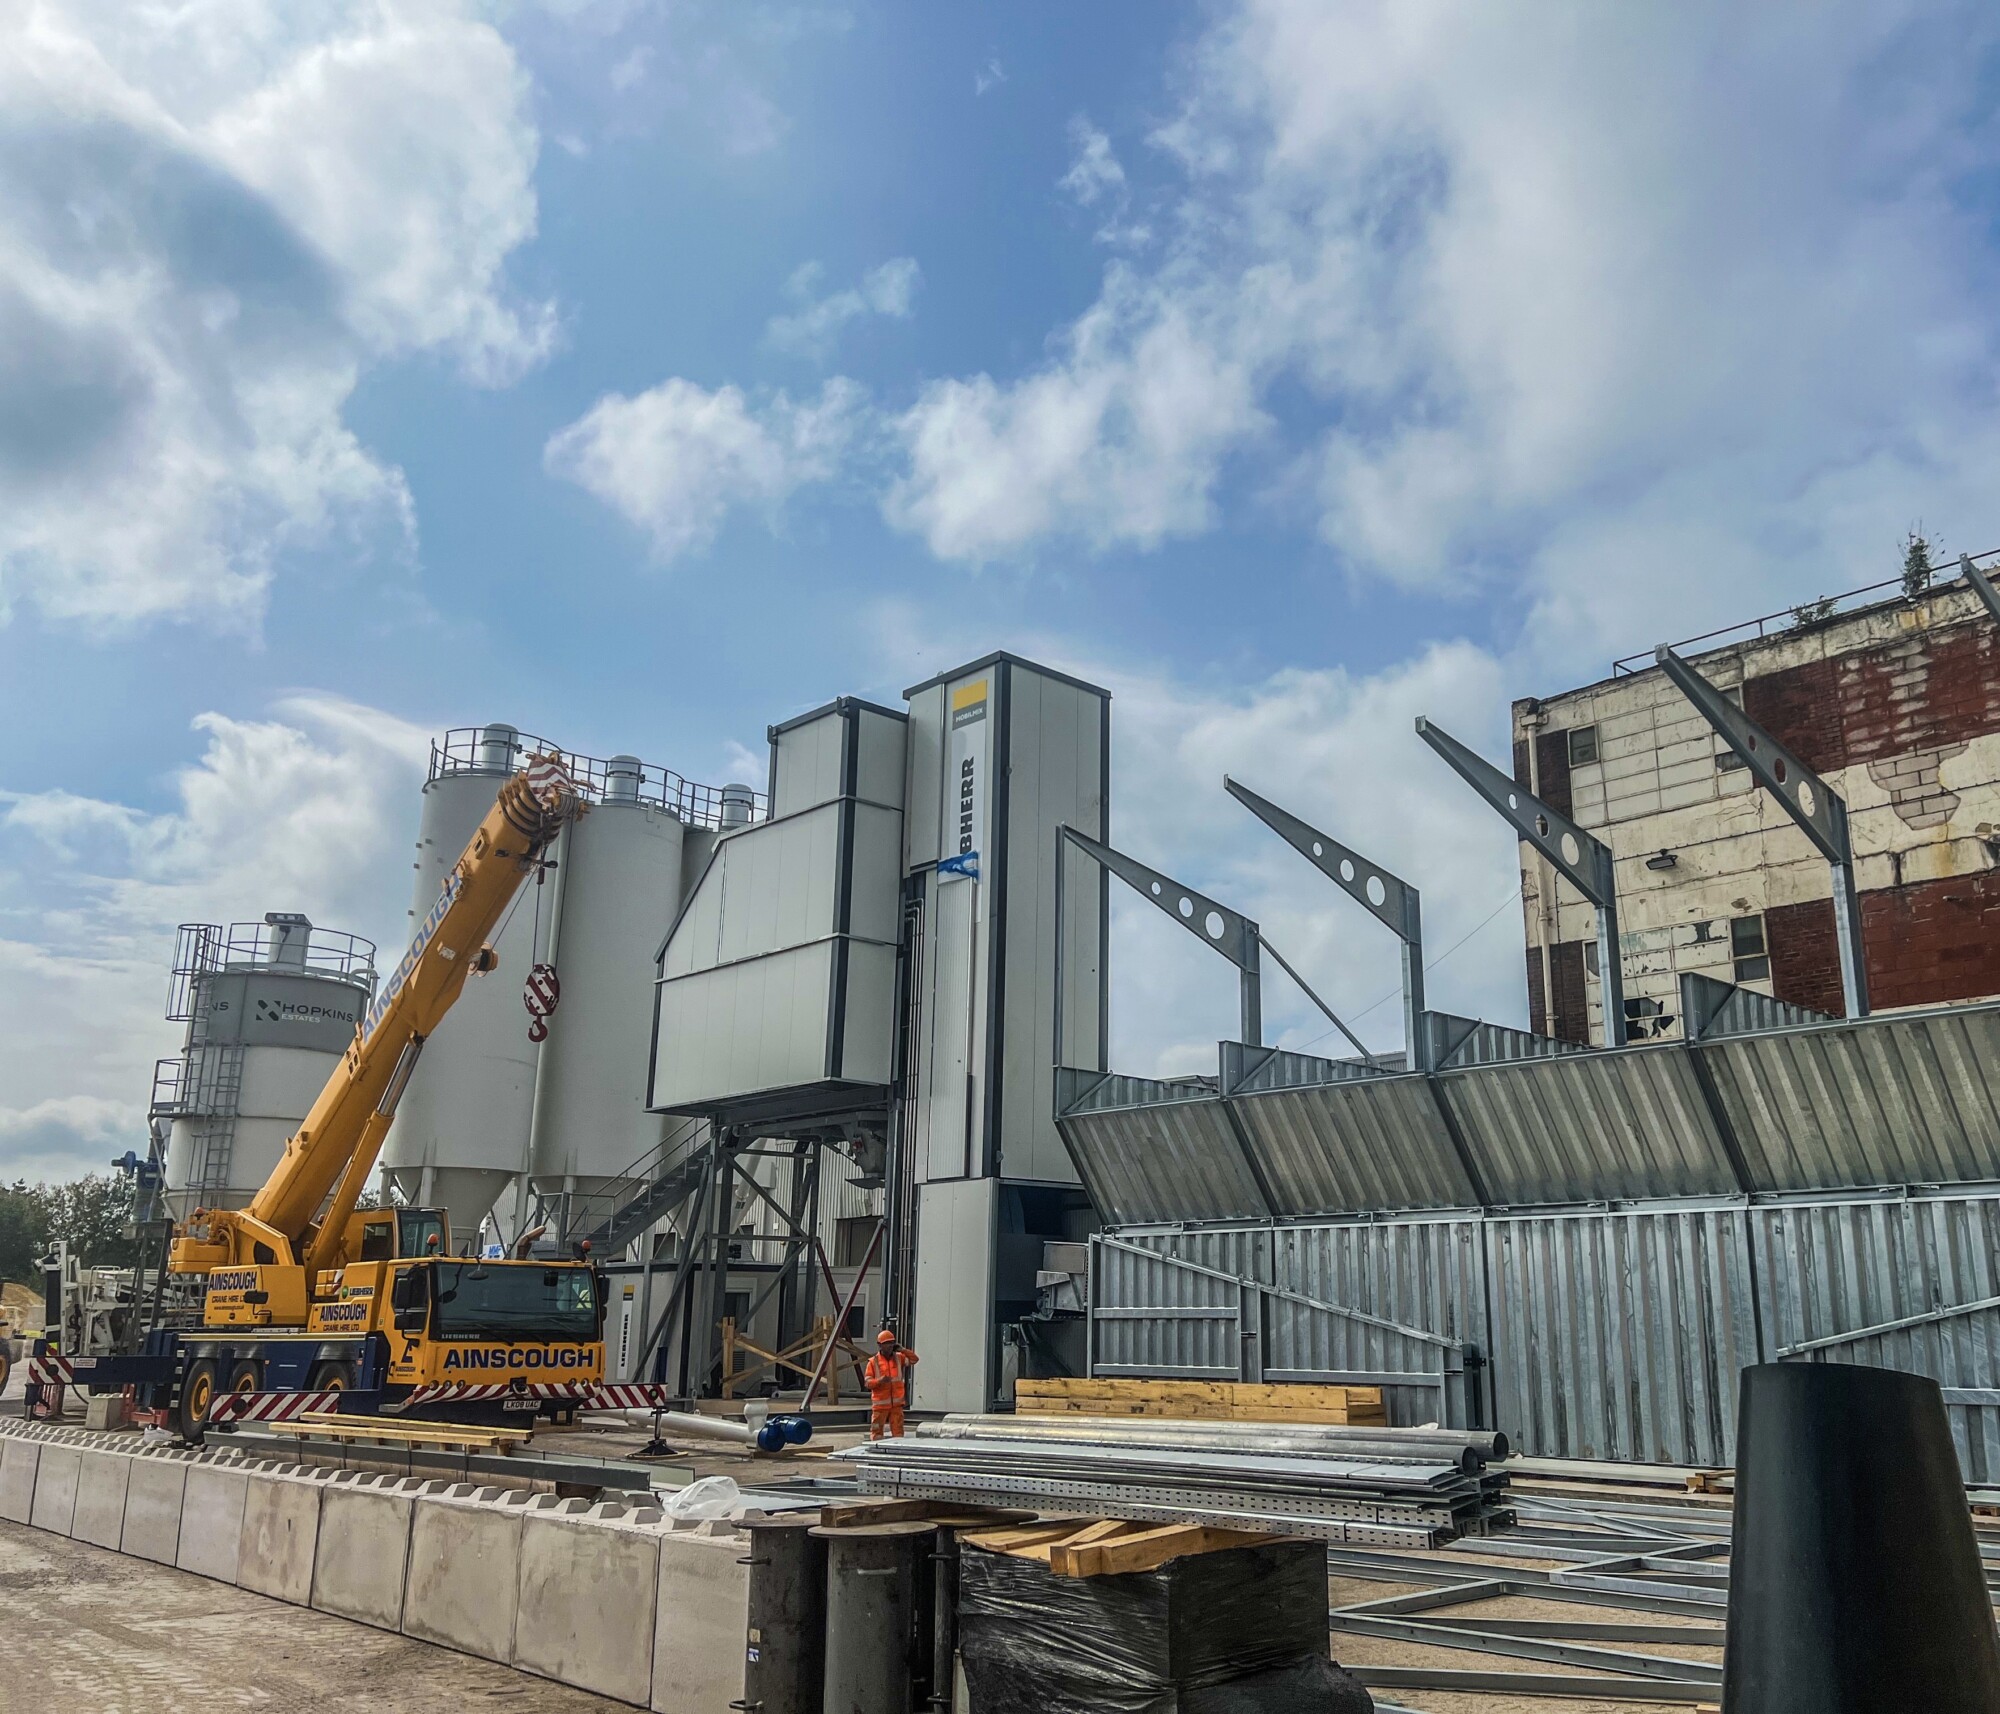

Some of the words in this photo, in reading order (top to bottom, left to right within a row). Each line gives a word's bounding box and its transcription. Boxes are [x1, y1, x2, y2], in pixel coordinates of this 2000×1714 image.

[955, 707, 984, 722] MOBILMIX
[960, 755, 975, 854] BHERR
[281, 1014, 321, 1023] ESTATES
[282, 1003, 354, 1023] HOPKINS
[209, 1272, 257, 1291] AINSCOUGH
[228, 1295, 239, 1303] HIRE
[350, 1287, 373, 1296] LIEBHERR
[320, 1303, 368, 1321] AINSCOUGH
[443, 1348, 594, 1369] AINSCOUGH
